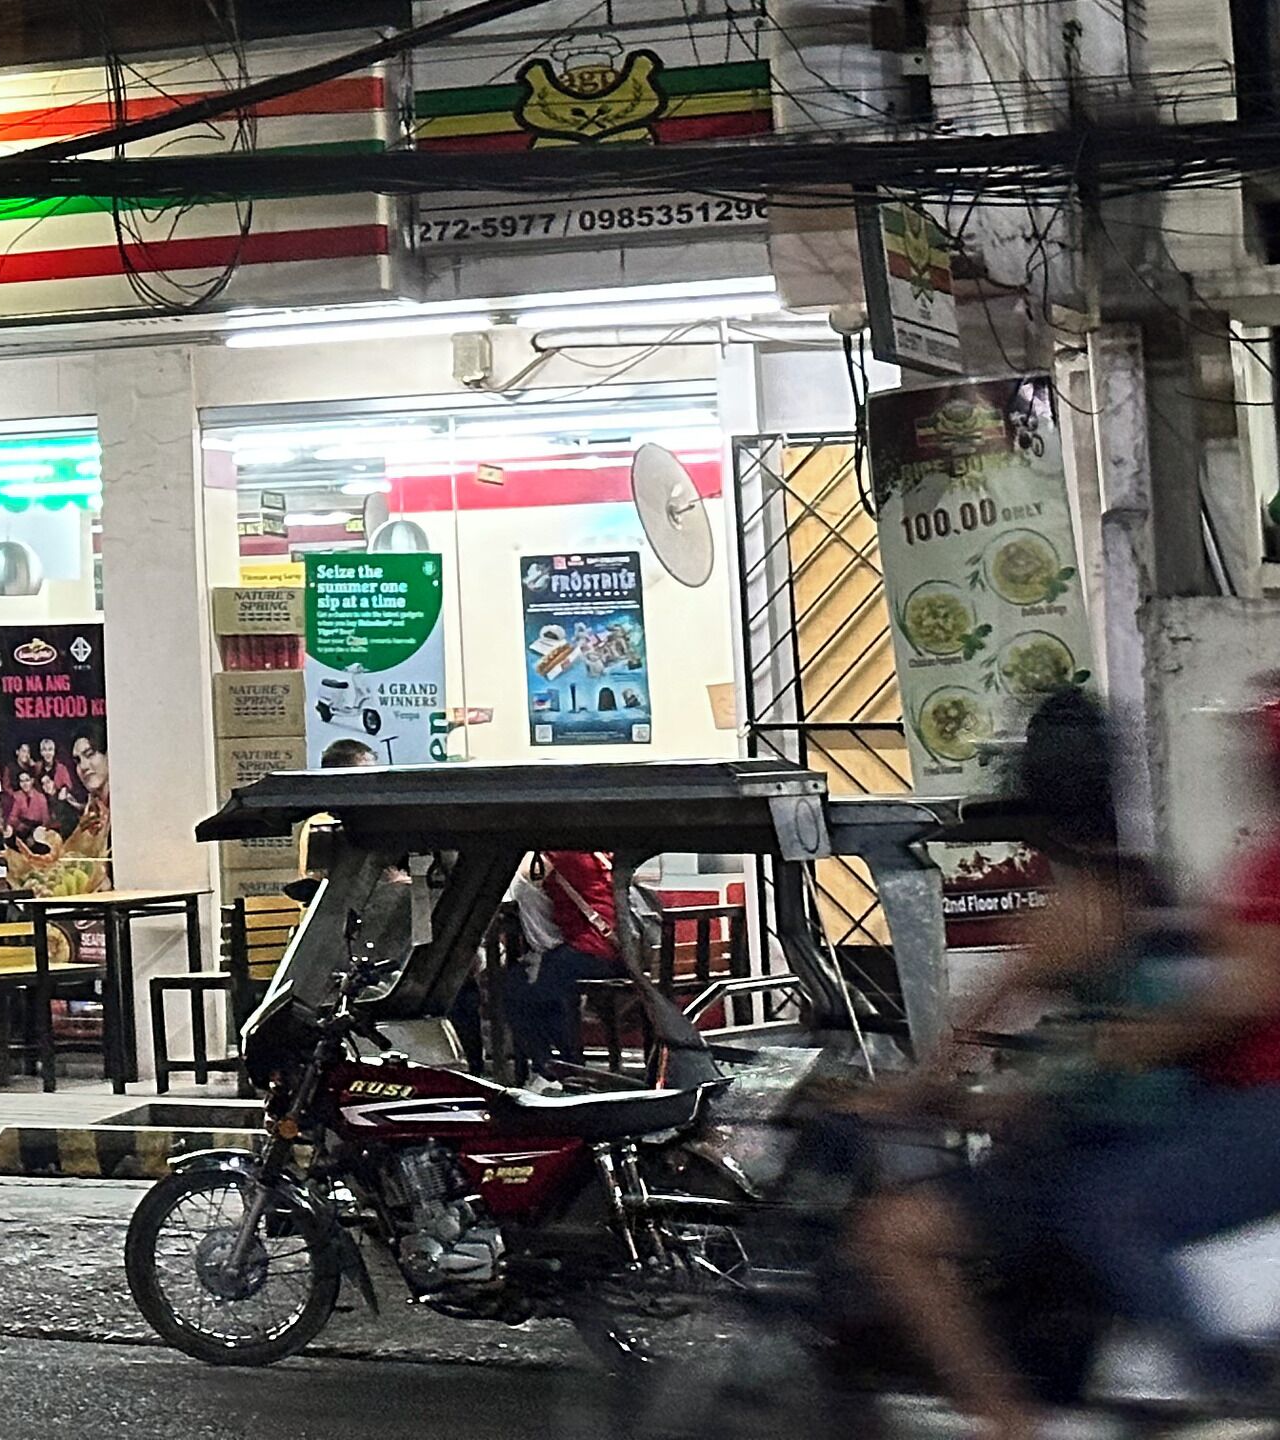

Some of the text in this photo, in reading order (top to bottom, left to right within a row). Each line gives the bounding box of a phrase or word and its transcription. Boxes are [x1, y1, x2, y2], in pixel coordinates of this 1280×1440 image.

[901, 497, 1043, 546] 100.00 ONLY
[317, 564, 383, 579] Seize the
[317, 582, 408, 594] summer one
[234, 591, 296, 601] NATURE'S
[317, 594, 406, 611] sip at a time
[239, 601, 288, 611] SPRING
[228, 685, 290, 696] NATURE'S
[377, 683, 438, 696] 4 GRAND
[14, 695, 88, 718] SEAFOOD
[234, 696, 283, 706] SPRING
[379, 695, 438, 708] WINNERS
[942, 895, 967, 914] 2nd
[968, 893, 999, 912] Floor
[1000, 891, 1015, 910] of
[348, 1079, 413, 1098] RUSI
